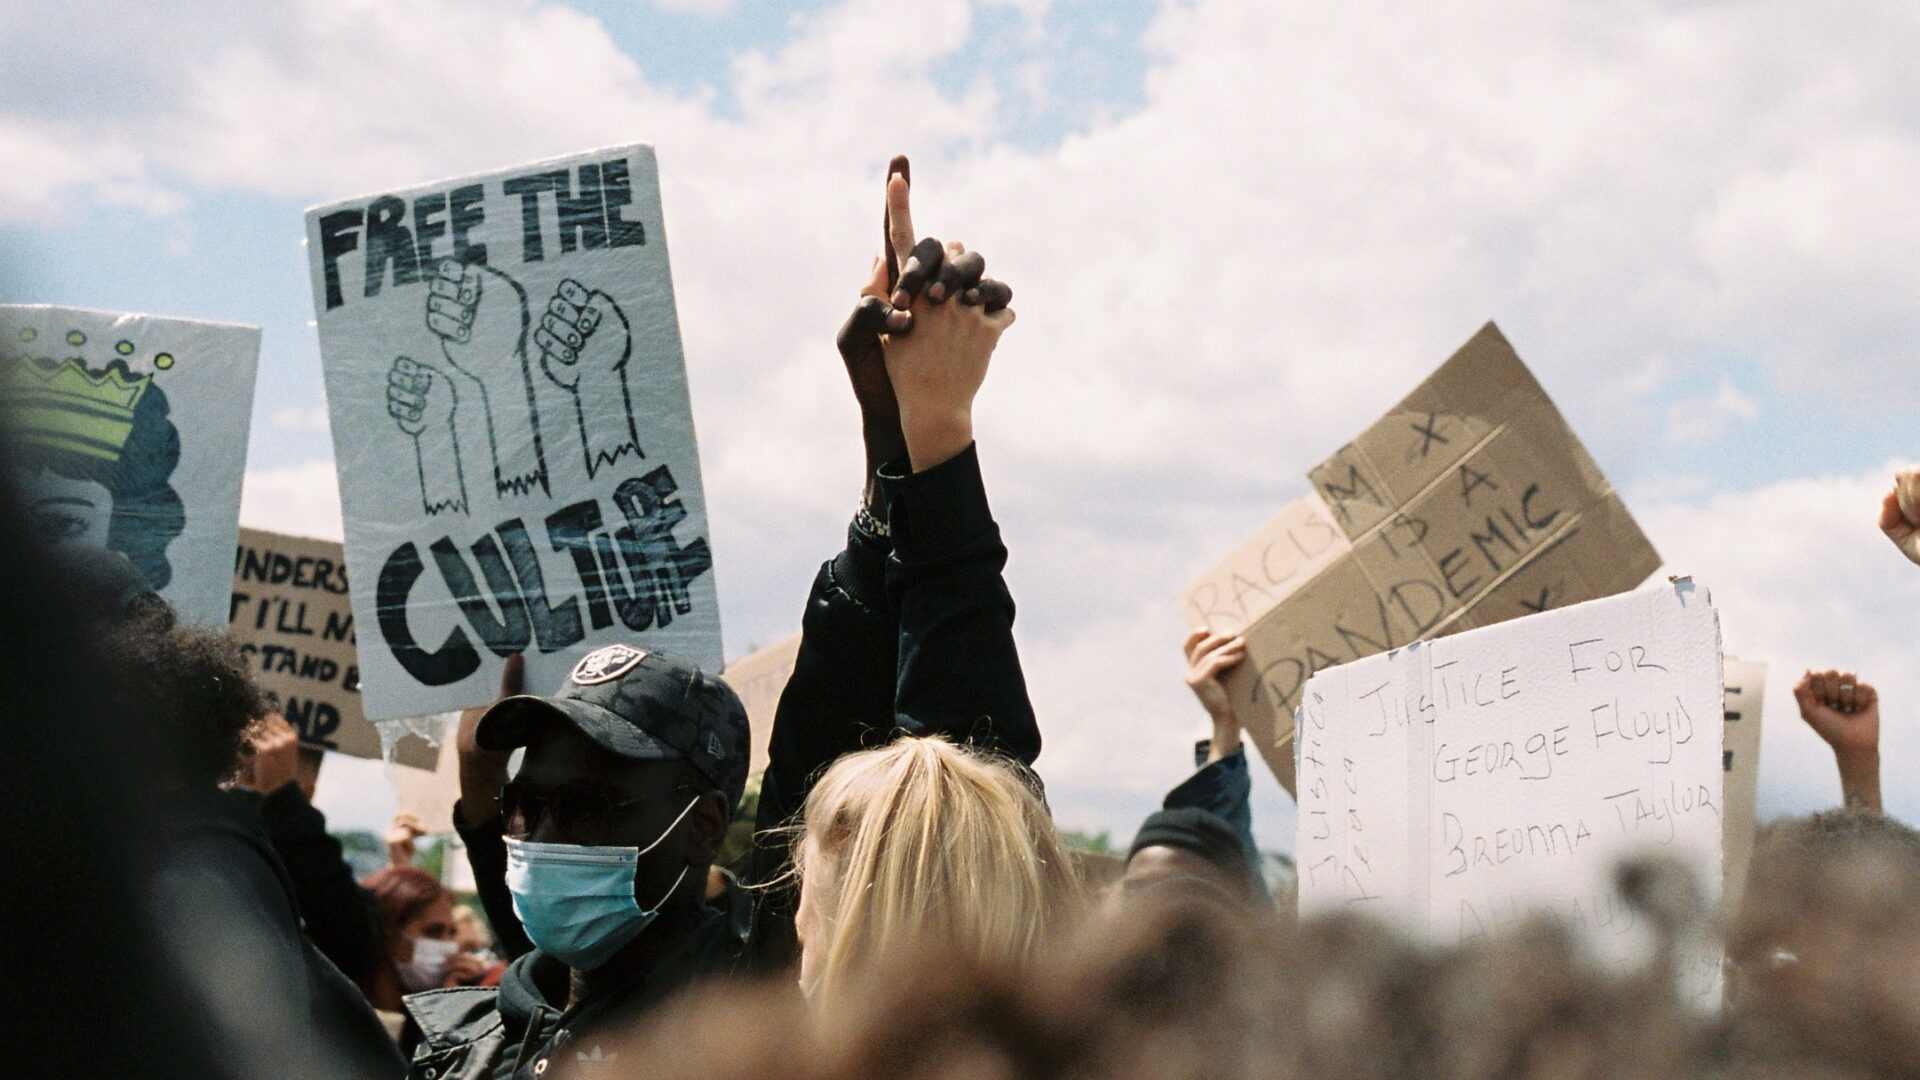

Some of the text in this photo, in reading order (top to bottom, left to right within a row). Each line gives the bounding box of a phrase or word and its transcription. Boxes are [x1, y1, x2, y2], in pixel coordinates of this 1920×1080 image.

[319, 158, 646, 312] FREE THE
[376, 464, 713, 687] CULTURE
[1190, 465, 1384, 627] RACISM
[1378, 464, 1498, 558] IS A
[256, 597, 314, 636] I'LL
[323, 612, 357, 647] N
[1253, 484, 1560, 718] PANDEMIC
[1569, 638, 1668, 682] FOR
